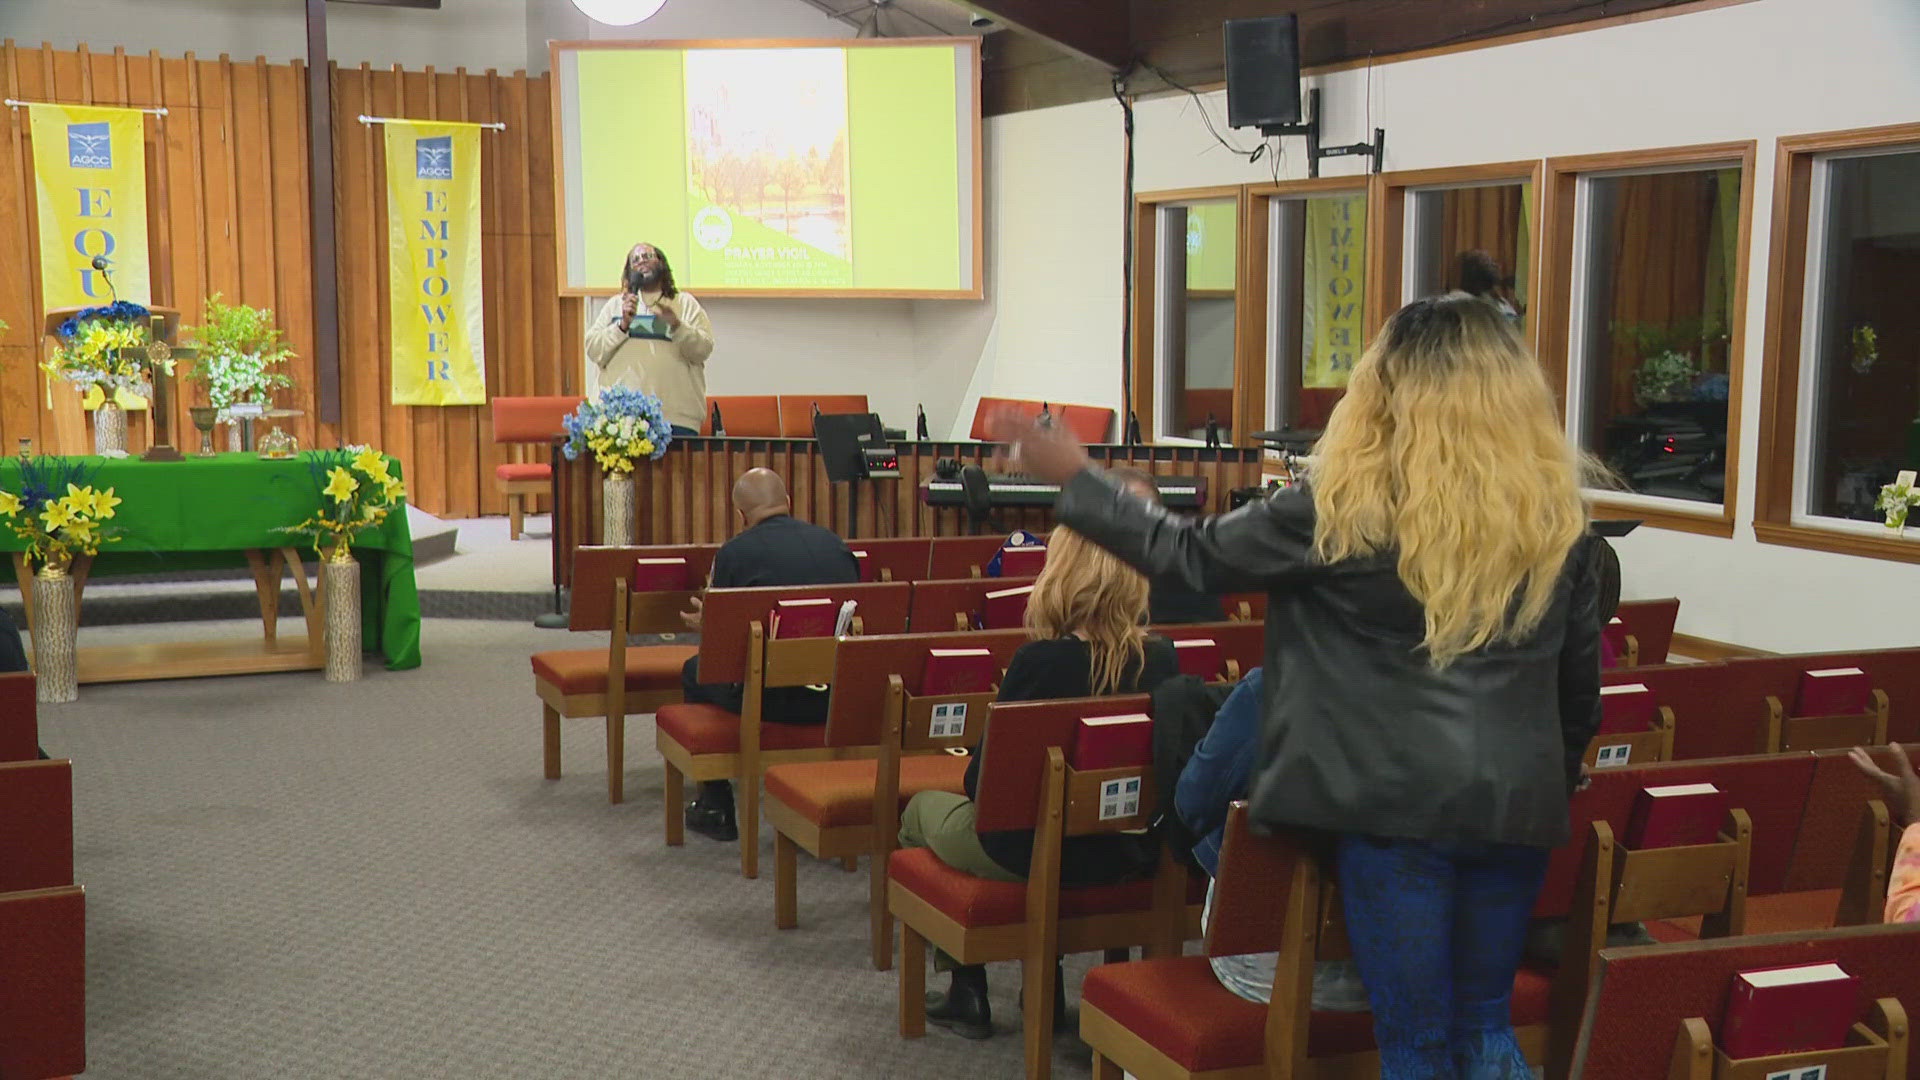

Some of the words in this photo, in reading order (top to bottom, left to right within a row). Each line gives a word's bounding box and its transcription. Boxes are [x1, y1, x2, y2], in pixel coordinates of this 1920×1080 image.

[72, 154, 110, 165] AGCC
[418, 167, 451, 176] AGCC
[724, 248, 775, 260] PRAYER
[778, 248, 810, 260] VIGIL
[419, 191, 451, 381] EMPOWER
